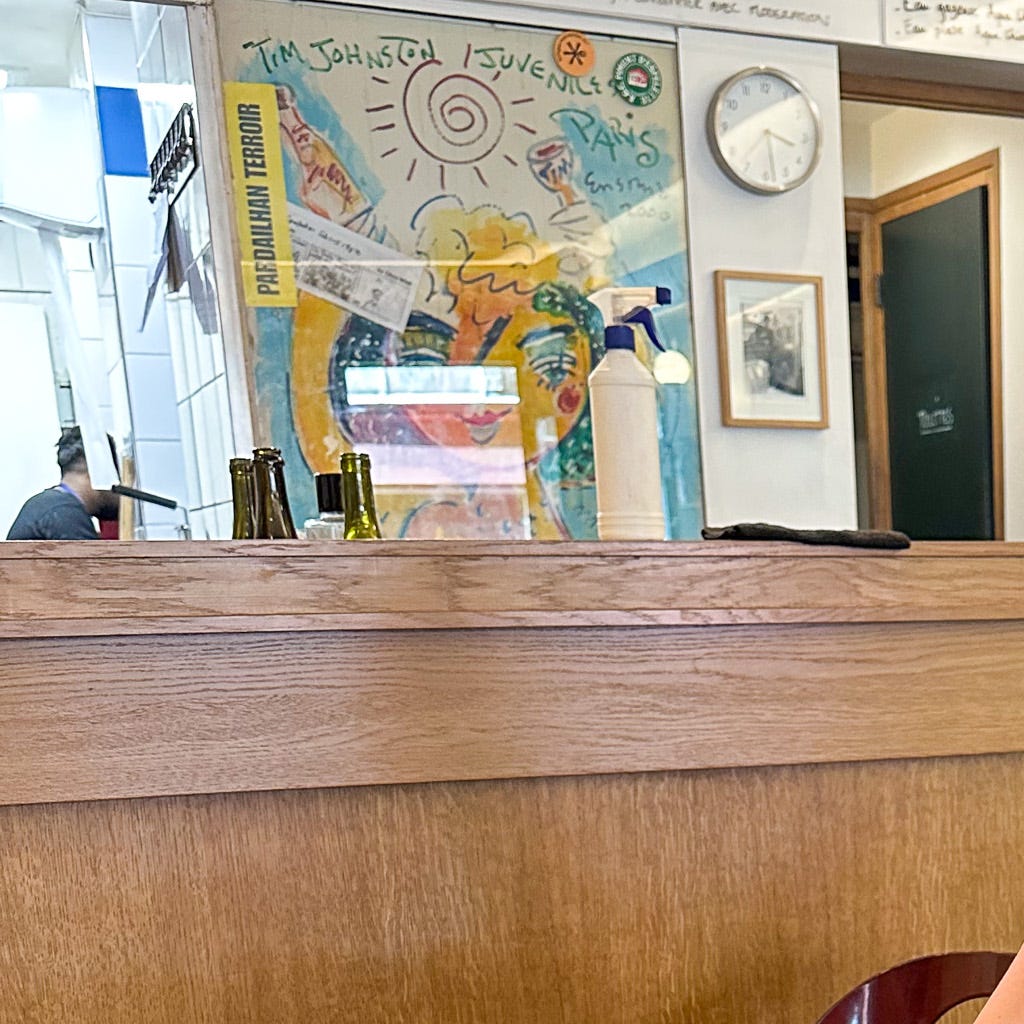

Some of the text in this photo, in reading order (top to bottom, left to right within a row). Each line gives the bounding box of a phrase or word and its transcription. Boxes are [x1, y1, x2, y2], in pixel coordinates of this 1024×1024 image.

[243, 36, 305, 73] TIM
[310, 36, 436, 72] JOHNSTON
[237, 102, 281, 296] PARDAILHAN TERROIR
